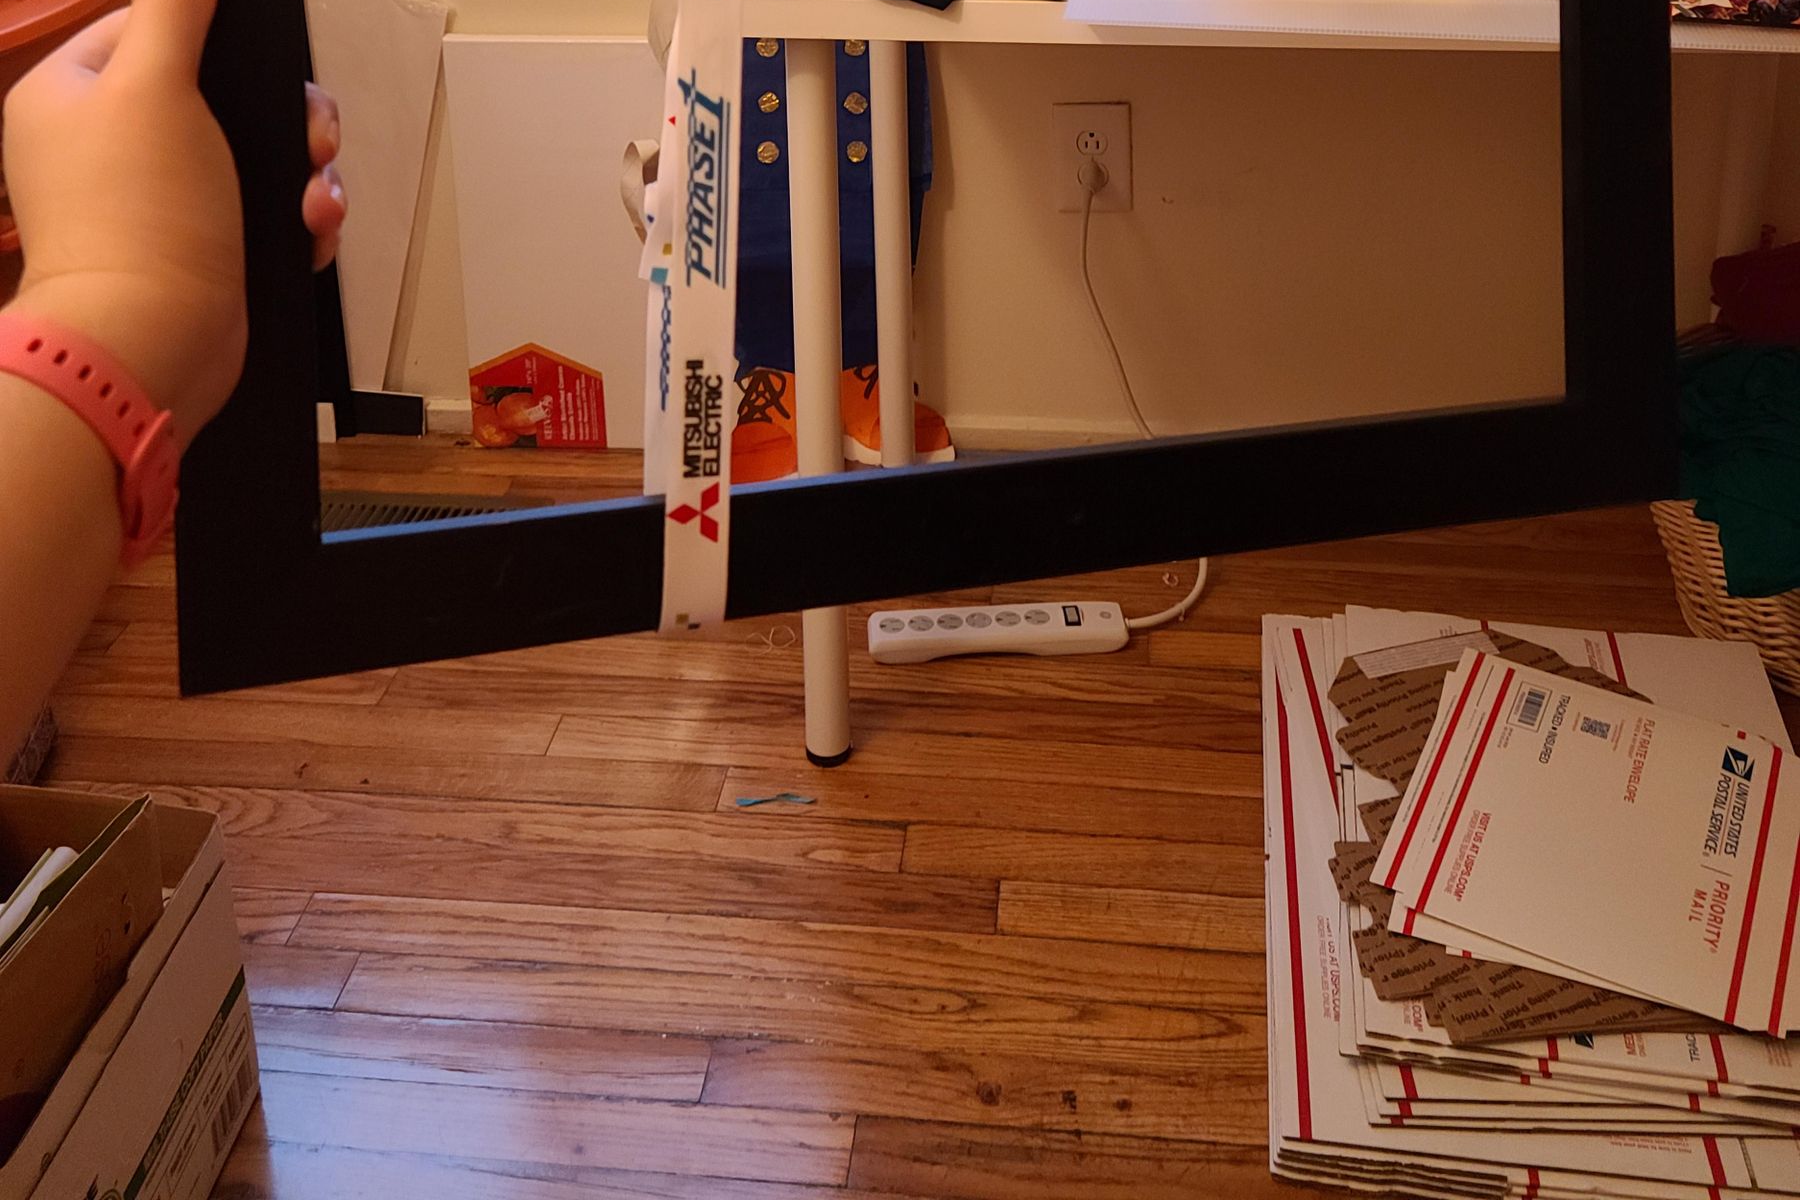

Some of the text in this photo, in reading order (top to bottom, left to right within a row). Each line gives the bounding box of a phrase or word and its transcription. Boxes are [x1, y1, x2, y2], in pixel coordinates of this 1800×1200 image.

[683, 359, 704, 478] MITSUBISHI
[703, 375, 723, 477] ELECTRIC
[1538, 694, 1571, 764] TRACKED INSURED
[1643, 719, 1655, 738] FLAT
[1635, 737, 1650, 760] RATE
[1624, 759, 1645, 804] ENVELOPE
[1714, 773, 1732, 812] POSTAL
[1473, 831, 1485, 843] US
[1479, 812, 1492, 832] VISIT
[1725, 782, 1749, 858] UNITED STATES
[1470, 842, 1480, 855] AT
[1688, 888, 1707, 922] MAIL
[1685, 1033, 1700, 1062] TRAC
